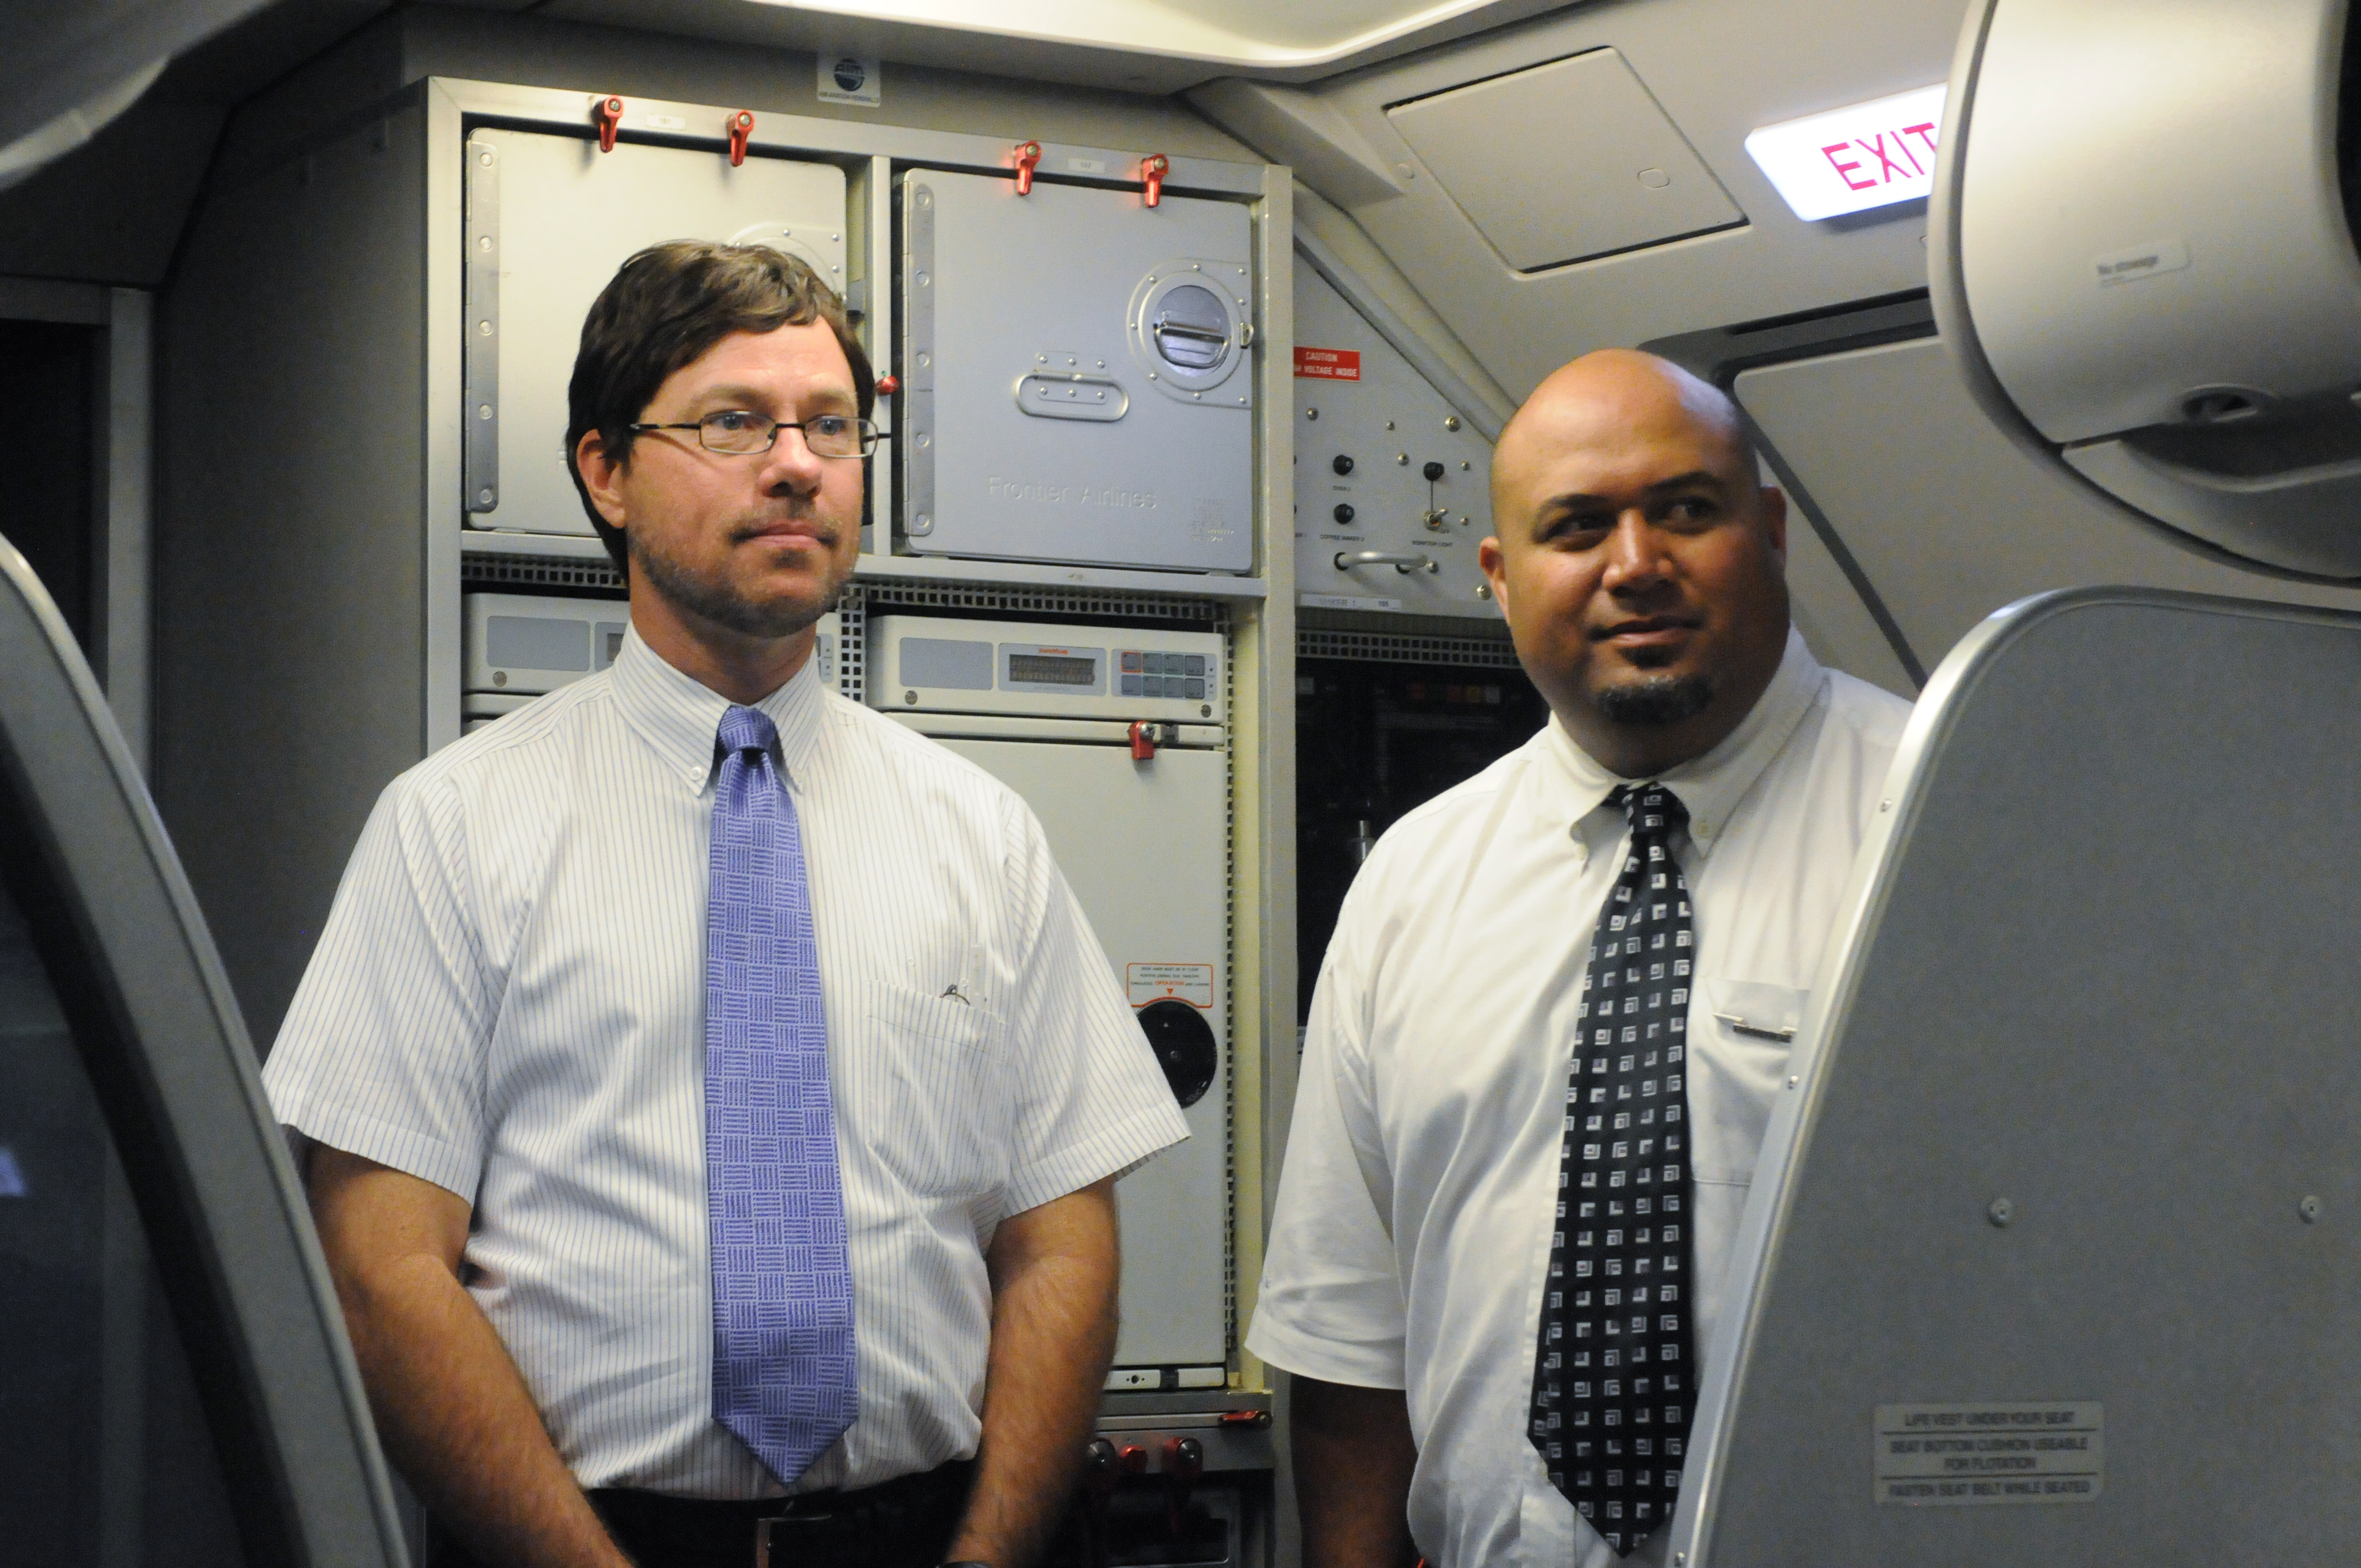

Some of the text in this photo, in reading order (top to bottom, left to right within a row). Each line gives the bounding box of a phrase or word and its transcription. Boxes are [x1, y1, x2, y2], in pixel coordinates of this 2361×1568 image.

[1821, 122, 1936, 191] EXIT
[1305, 351, 1337, 362] CAUTION
[2010, 1412, 2042, 1424] YOUR
[1944, 1458, 1969, 1470] FOR
